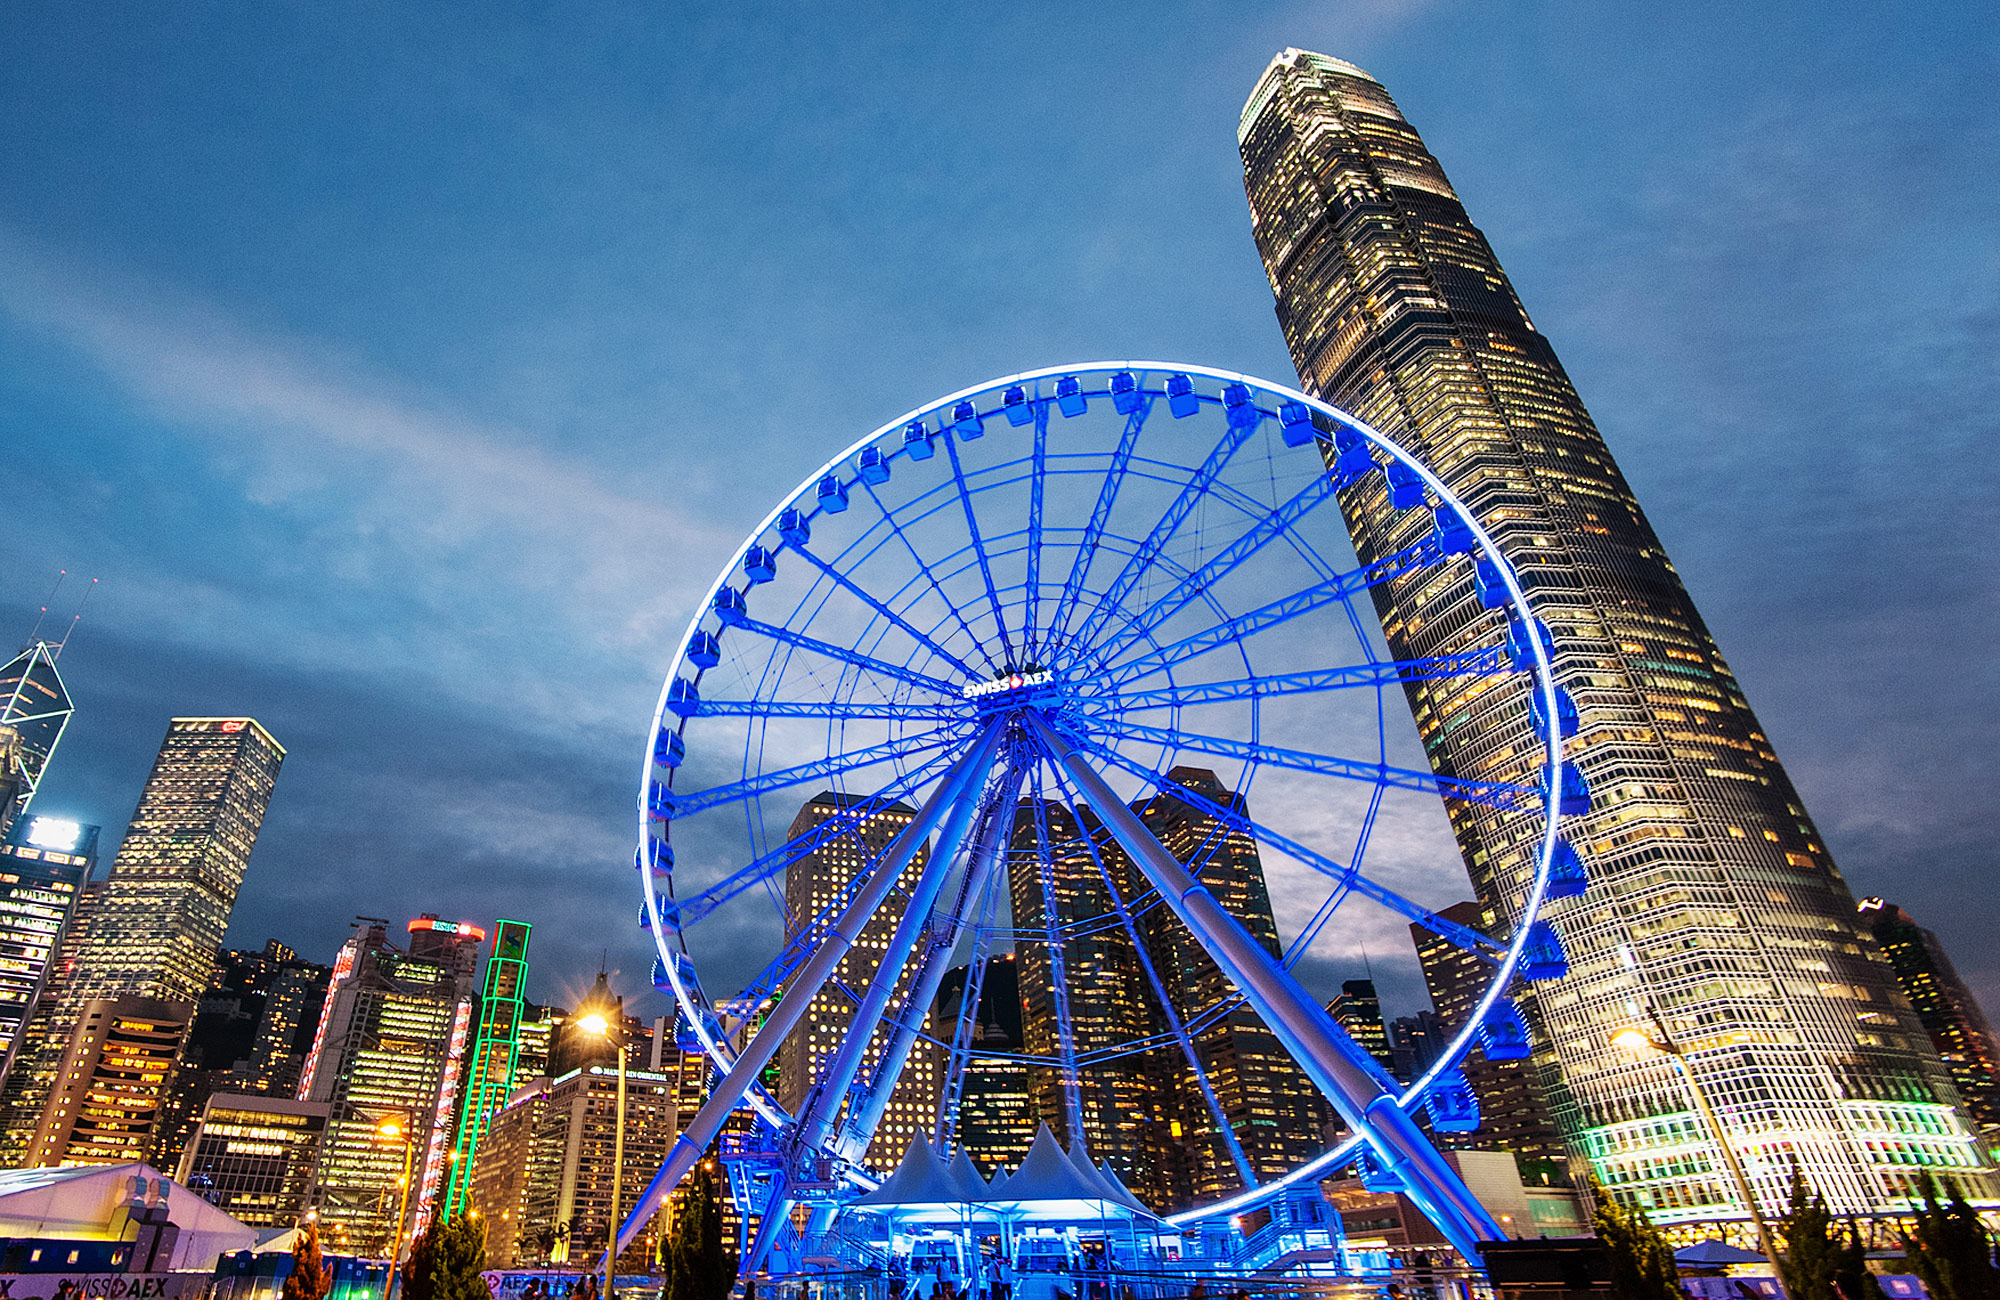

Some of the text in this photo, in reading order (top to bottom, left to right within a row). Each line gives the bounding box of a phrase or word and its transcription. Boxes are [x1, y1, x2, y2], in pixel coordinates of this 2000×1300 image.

[963, 669, 1054, 698] SWISS AEX
[604, 1068, 636, 1078] MANDRIN
[126, 1278, 169, 1299] AEX
